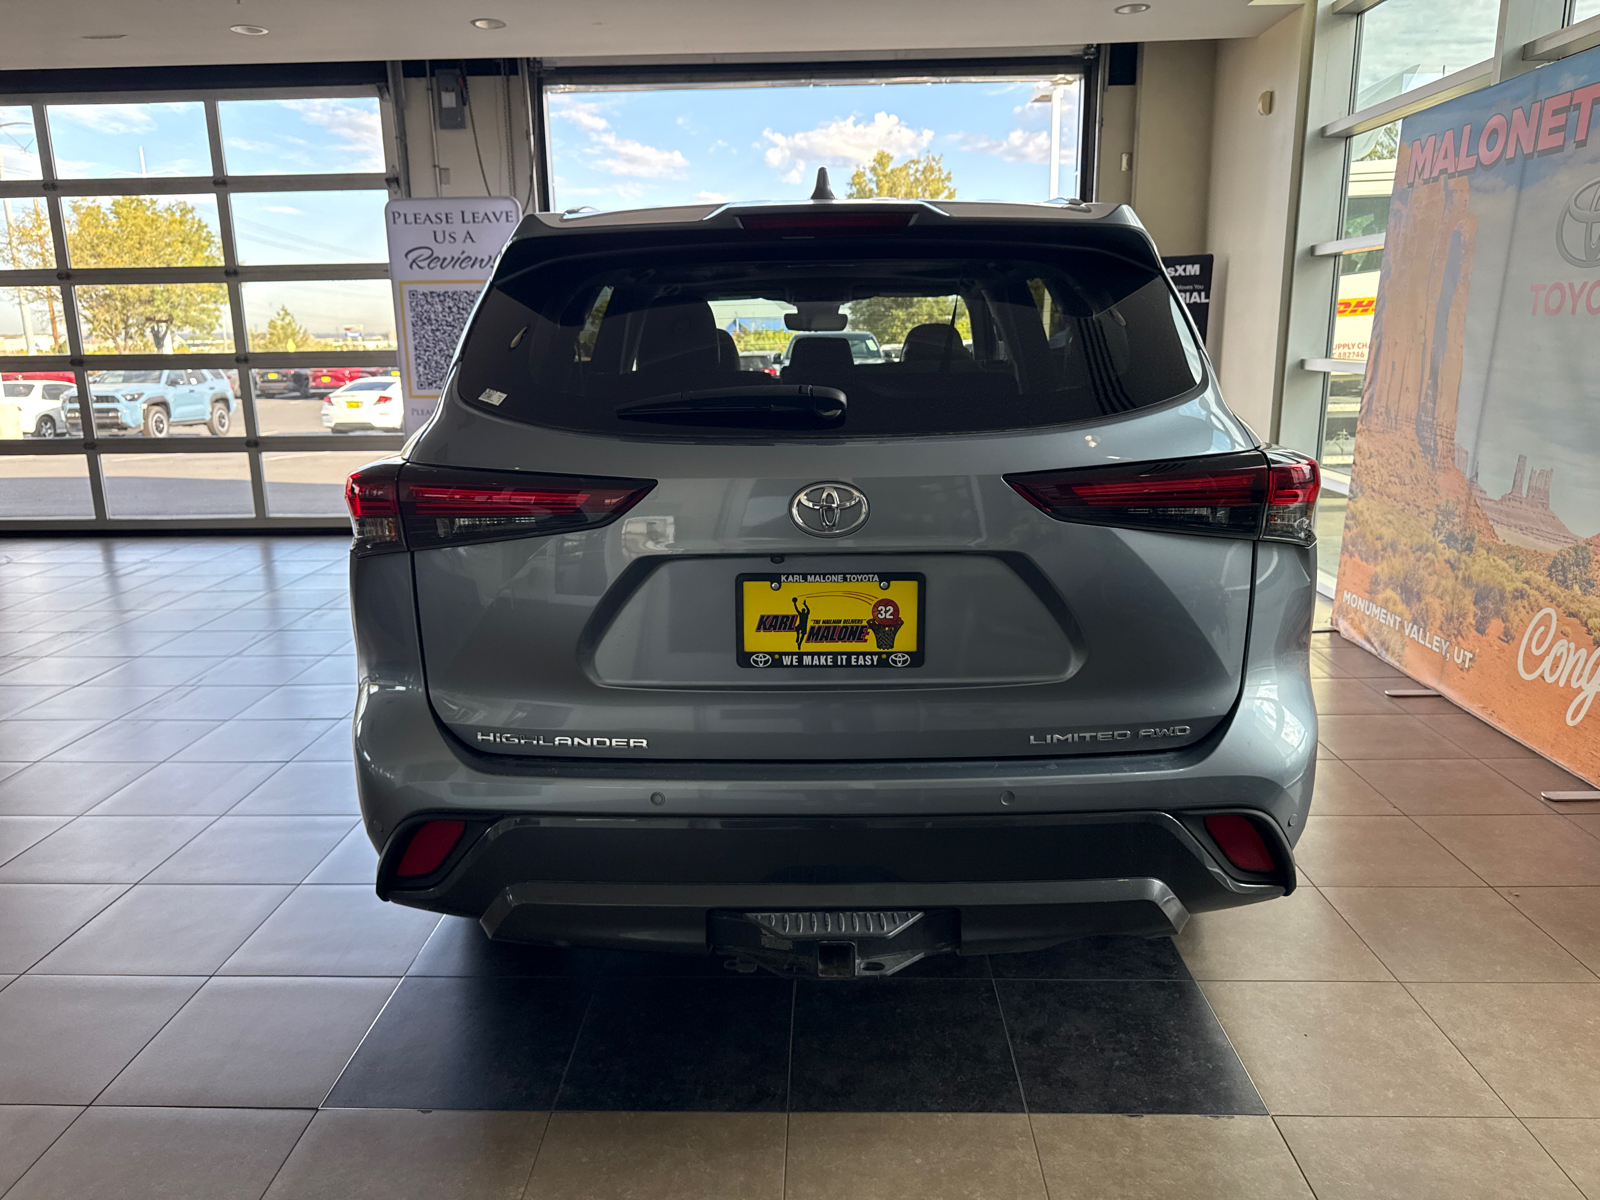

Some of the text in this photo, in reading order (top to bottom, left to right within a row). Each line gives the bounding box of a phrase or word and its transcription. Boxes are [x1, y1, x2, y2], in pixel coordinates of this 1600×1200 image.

[1407, 82, 1600, 188] MALONET
[391, 209, 515, 226] PLEASE LEAVE
[463, 230, 477, 244] A
[1337, 300, 1376, 314] DH
[1357, 341, 1370, 350] CH
[411, 407, 434, 416] PLEA
[781, 574, 879, 583] KARL MALONE TOYOTA
[877, 605, 894, 619] 32
[755, 614, 799, 633] KARL
[1342, 589, 1474, 669] MONUMENT VALLEY, UT
[805, 625, 870, 643] MALONE
[782, 655, 879, 666] WE MAKE IT EASY
[476, 731, 649, 749] HIGHLANDER
[1029, 725, 1191, 745] LIMITED AWD
